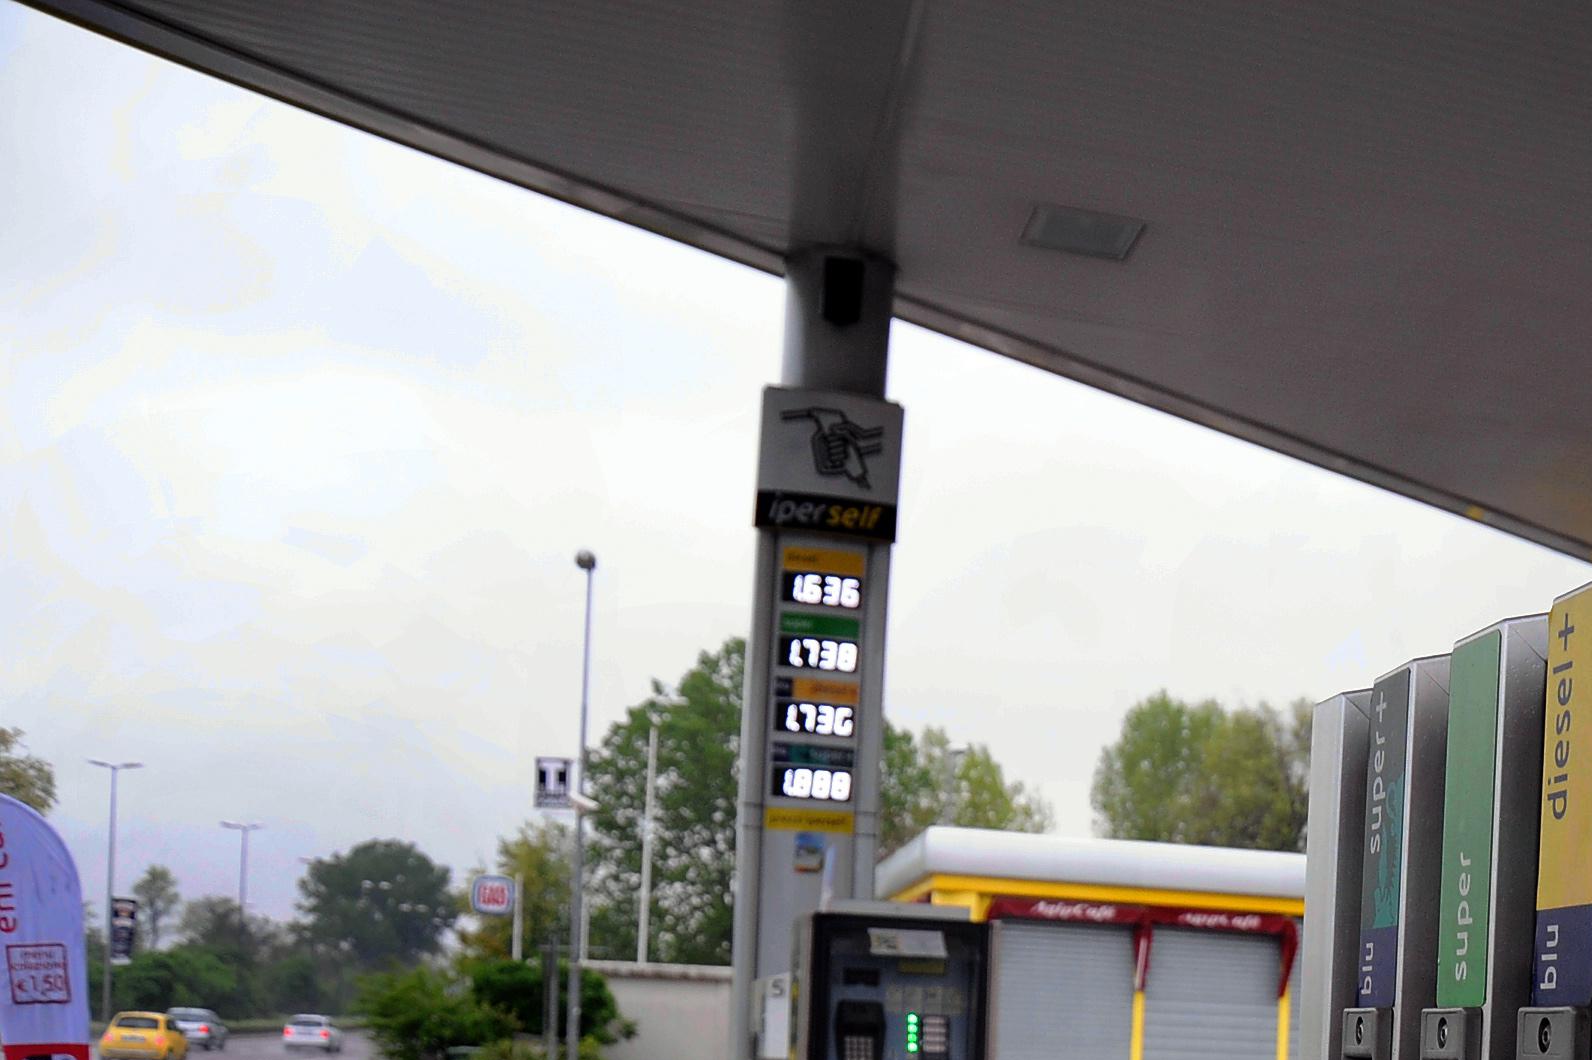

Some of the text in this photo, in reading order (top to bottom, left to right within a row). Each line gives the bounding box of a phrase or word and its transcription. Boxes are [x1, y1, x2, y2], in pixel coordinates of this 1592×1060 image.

[768, 491, 883, 530] iperself
[1547, 660, 1574, 820] diesel
[1370, 730, 1388, 854] super
[1455, 852, 1473, 981] super
[1539, 924, 1559, 990] blu
[1360, 942, 1374, 995] blu
